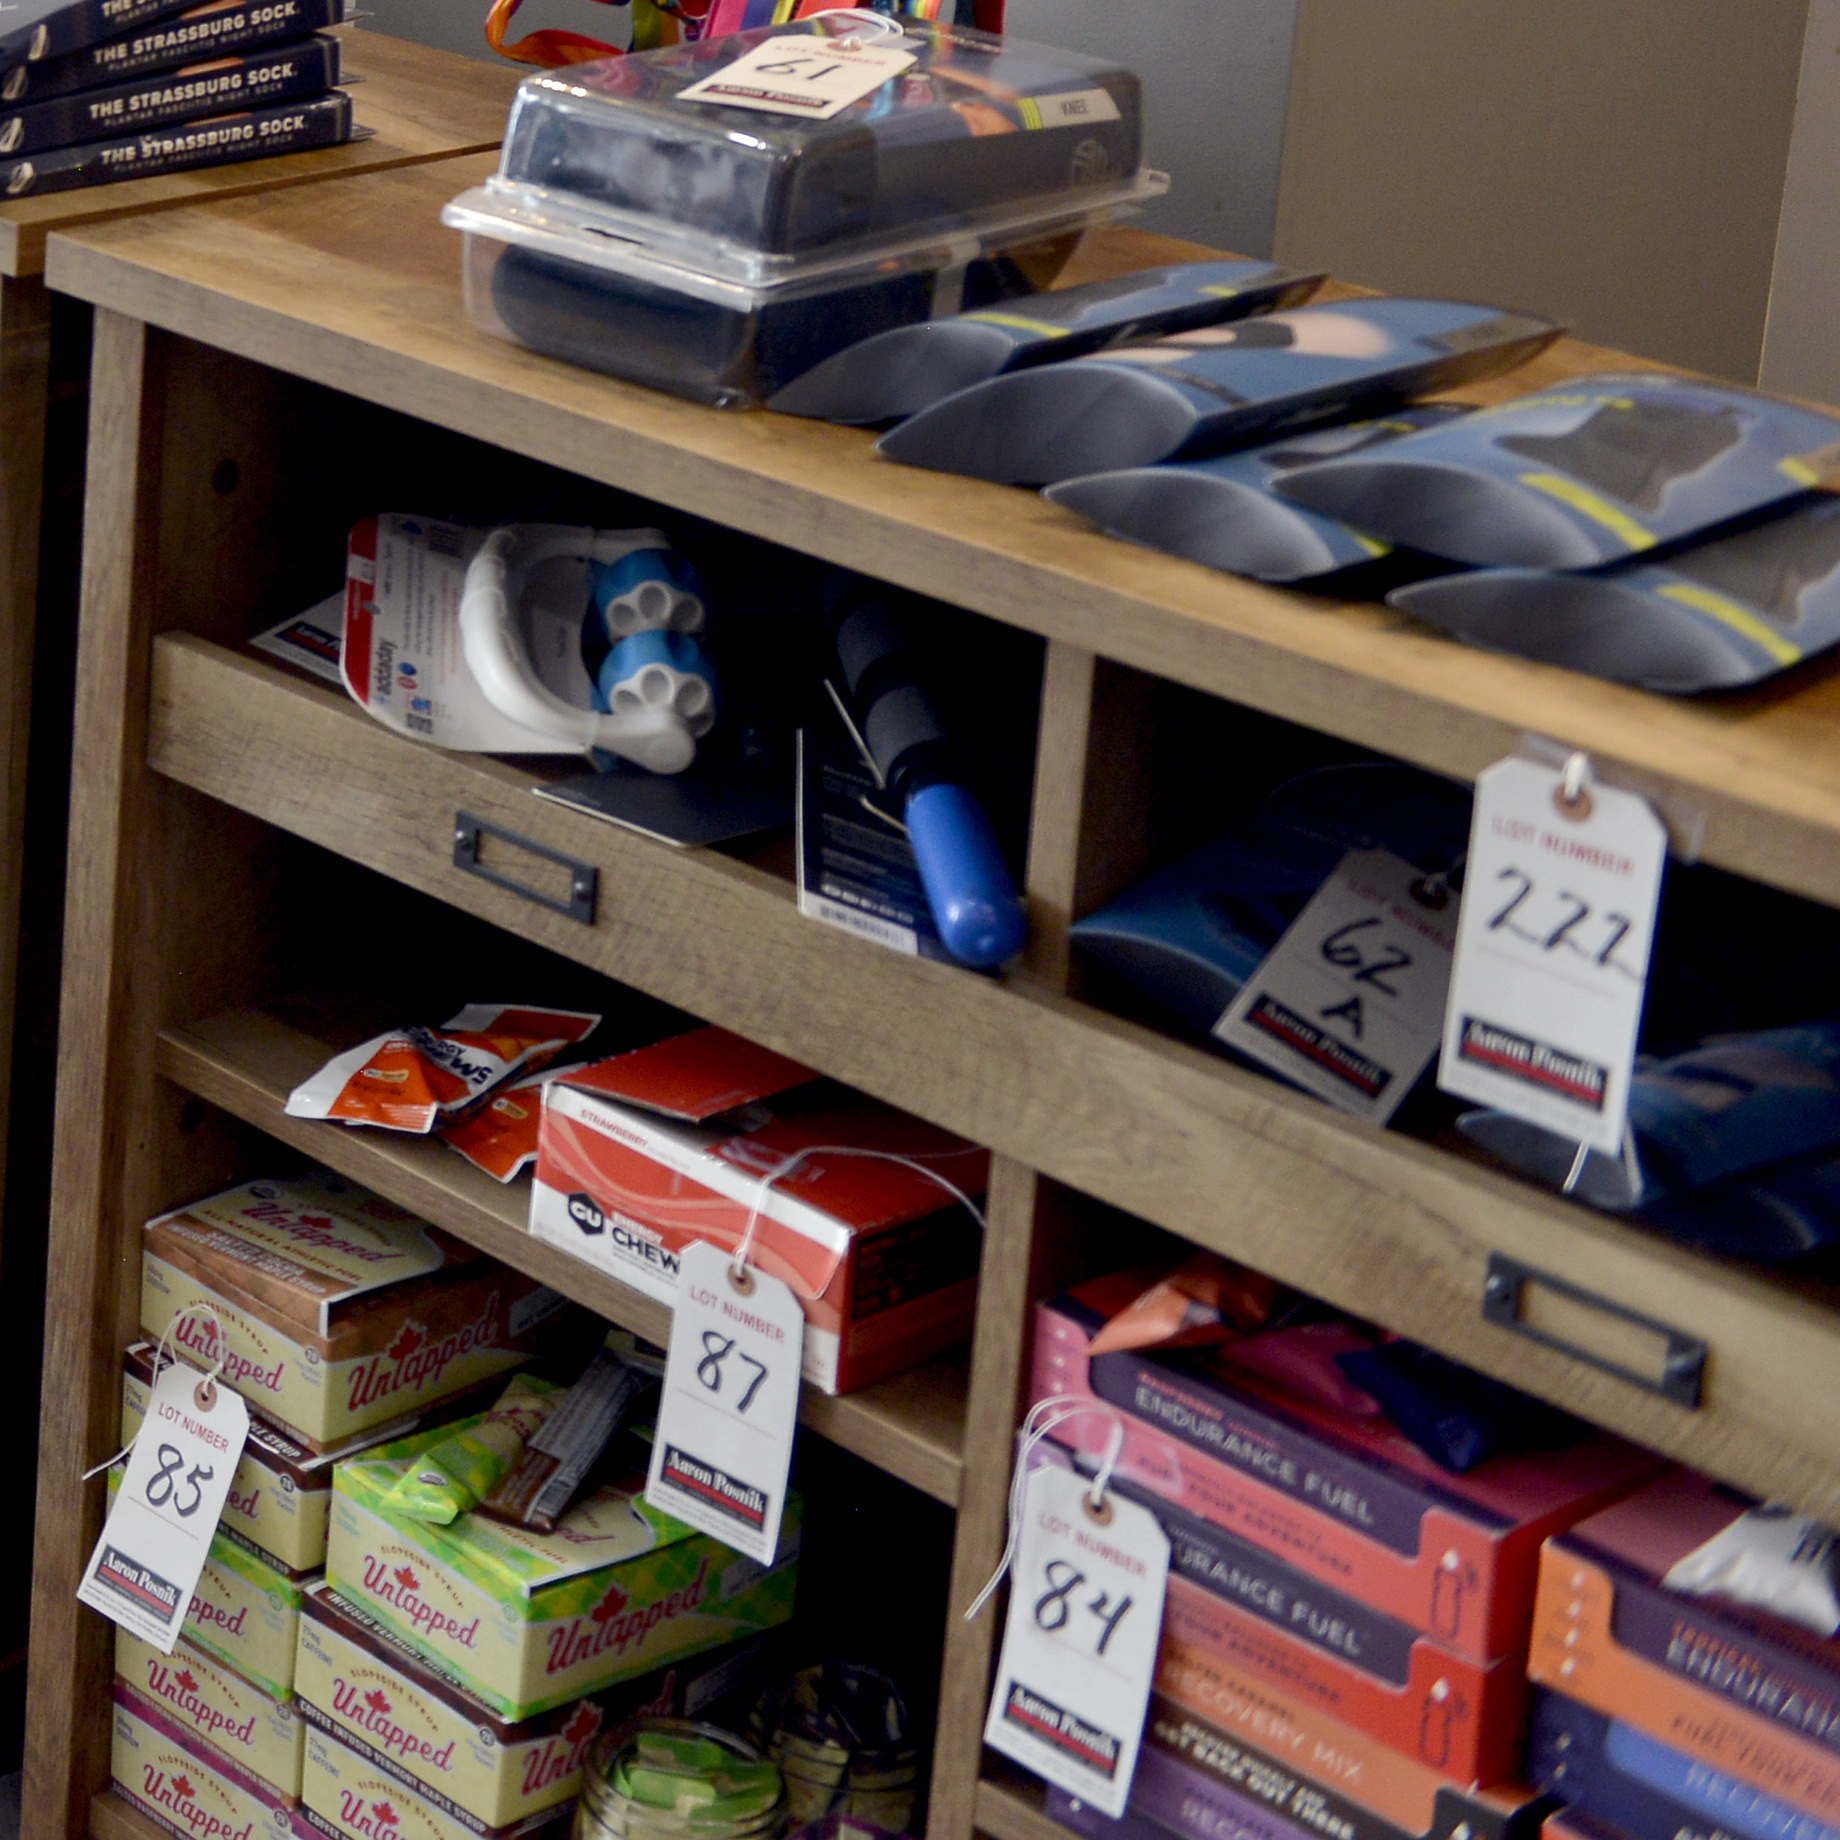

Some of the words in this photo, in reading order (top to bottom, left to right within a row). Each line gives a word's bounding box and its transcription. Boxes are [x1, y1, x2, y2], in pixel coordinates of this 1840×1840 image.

[93, 44, 128, 66] THE
[132, 15, 245, 56] STRASSBURG
[250, 0, 297, 27] SOCK
[754, 54, 832, 86] 61
[89, 98, 124, 120] THE
[129, 73, 243, 111] STRASSBURG
[247, 62, 294, 87] SOCK
[101, 146, 137, 166] THE
[141, 124, 255, 160] STRASSBURG
[259, 114, 305, 139] SOCK
[1320, 917, 1413, 996] 62
[1485, 866, 1645, 980] 222
[579, 1108, 650, 1147] STRAWBERRY
[569, 1199, 603, 1228] GU
[611, 1226, 680, 1274] CHEW
[173, 1309, 287, 1393] Untapped
[346, 1290, 501, 1413] Untapped
[690, 1286, 720, 1311] LOT
[722, 1302, 786, 1344] NUMBER
[696, 1330, 769, 1414] 87
[157, 1401, 180, 1423] LOT
[182, 1417, 230, 1454] NUMBER
[1134, 1385, 1300, 1488] ENDURANCE
[1304, 1466, 1373, 1526] FUEL
[145, 1443, 214, 1519] 85
[666, 1448, 711, 1483] Aaron
[713, 1468, 767, 1514] Posnik
[105, 1551, 140, 1584] Aaron
[139, 1570, 180, 1609] Posnik
[363, 1552, 482, 1653] Untapped
[545, 1553, 711, 1676] Untapped
[1034, 1560, 1134, 1657] 84
[1290, 1593, 1363, 1656] FUEL
[146, 1658, 258, 1748] Untapped
[332, 1676, 457, 1774] Untapped
[299, 1699, 334, 1733] COFFEE
[334, 1721, 375, 1757] INFUSED
[373, 1746, 420, 1787] VERMONT
[418, 1776, 453, 1811] MAPLE
[452, 1800, 487, 1836] SYRUP
